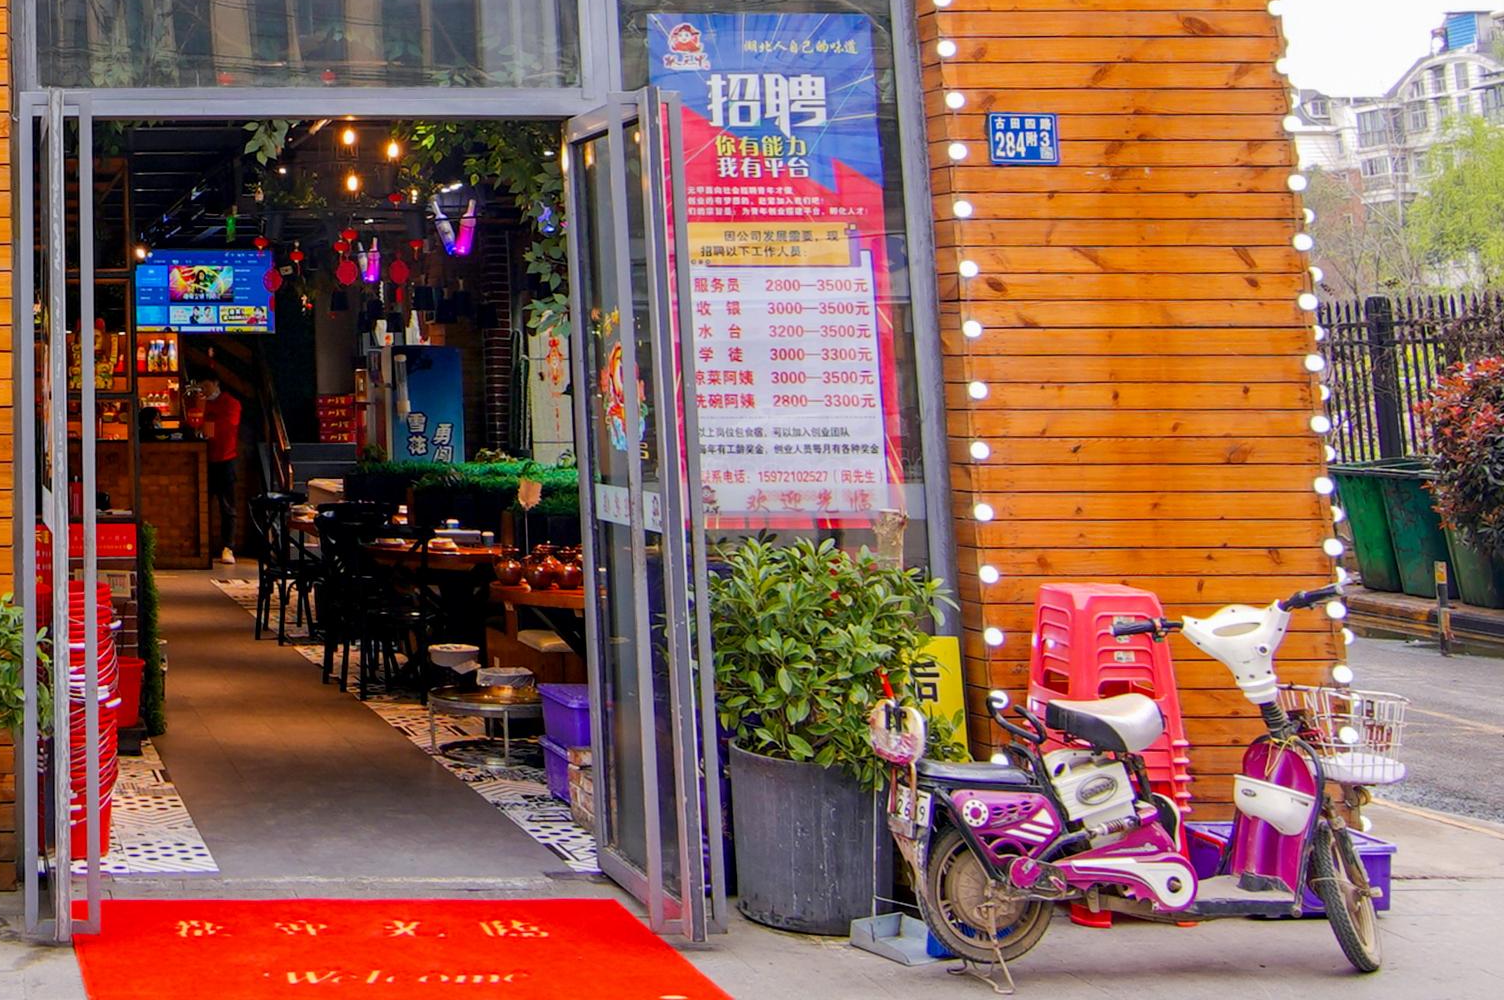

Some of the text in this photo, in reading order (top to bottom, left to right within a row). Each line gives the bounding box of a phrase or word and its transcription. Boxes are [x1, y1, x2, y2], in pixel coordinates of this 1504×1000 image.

[705, 73, 828, 138] 招聘
[714, 135, 809, 157] 你有能力
[716, 156, 810, 179] 我有平台
[694, 277, 741, 293] 服务员
[696, 301, 742, 316] 收银
[698, 324, 743, 340] 水台
[698, 347, 744, 363] 学徒
[407, 412, 427, 455] 雪花
[758, 470, 829, 484] 15972102527
